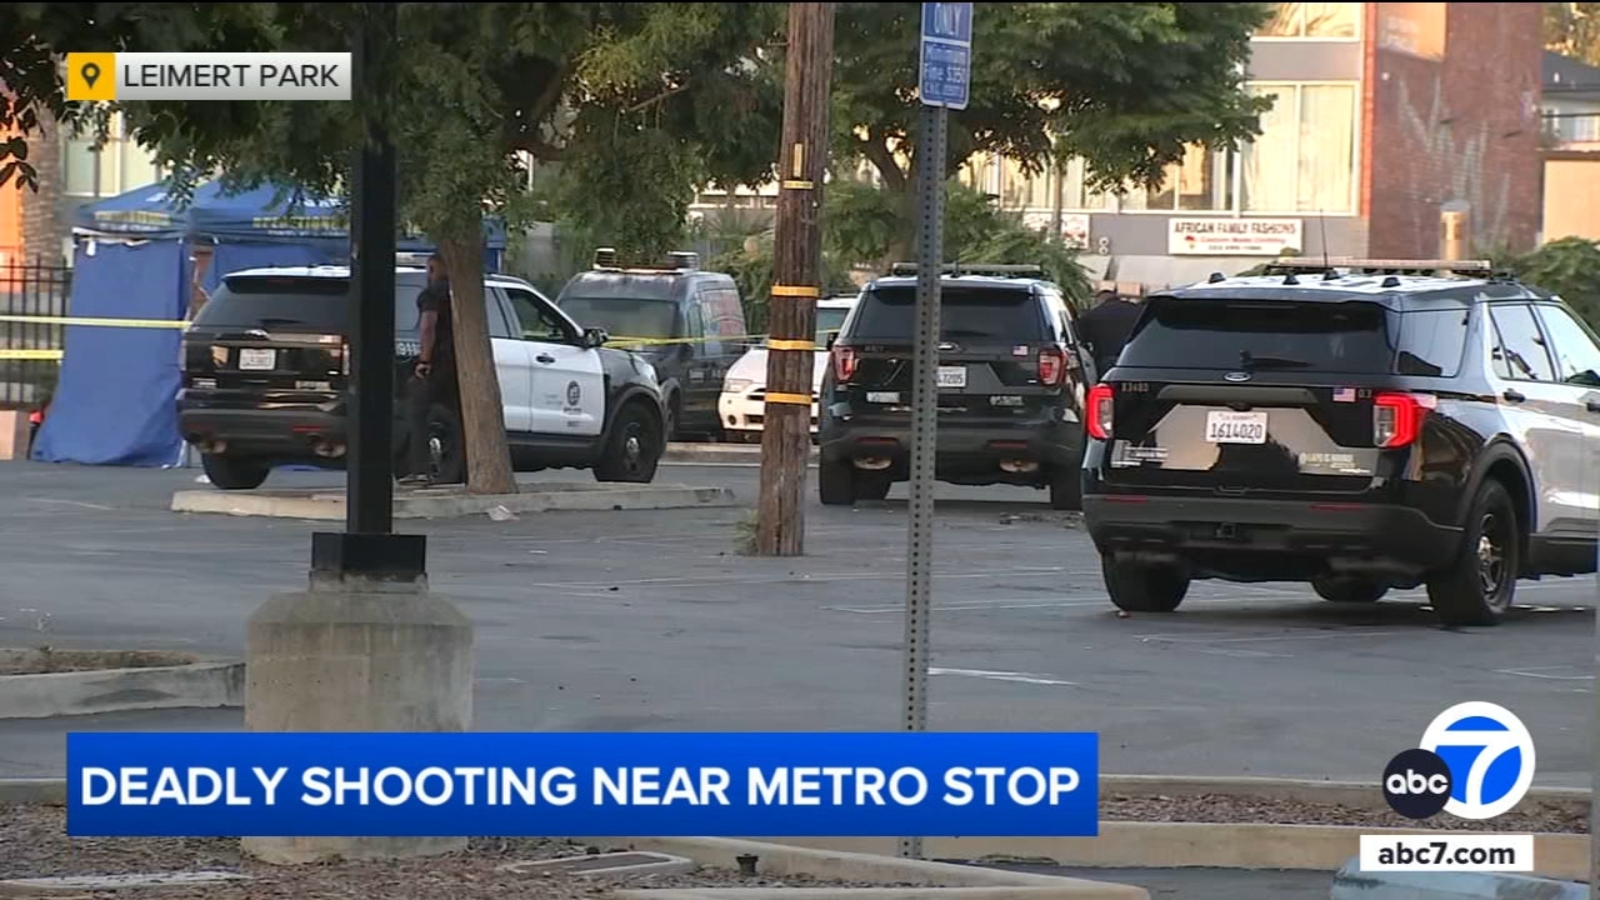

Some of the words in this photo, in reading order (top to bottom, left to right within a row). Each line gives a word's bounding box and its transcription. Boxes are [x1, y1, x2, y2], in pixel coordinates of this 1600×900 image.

[934, 3, 961, 37] ONLY
[1174, 222, 1214, 234] AFRICAN
[1217, 223, 1248, 234] FAMILY
[1251, 223, 1296, 234] FASHIONS
